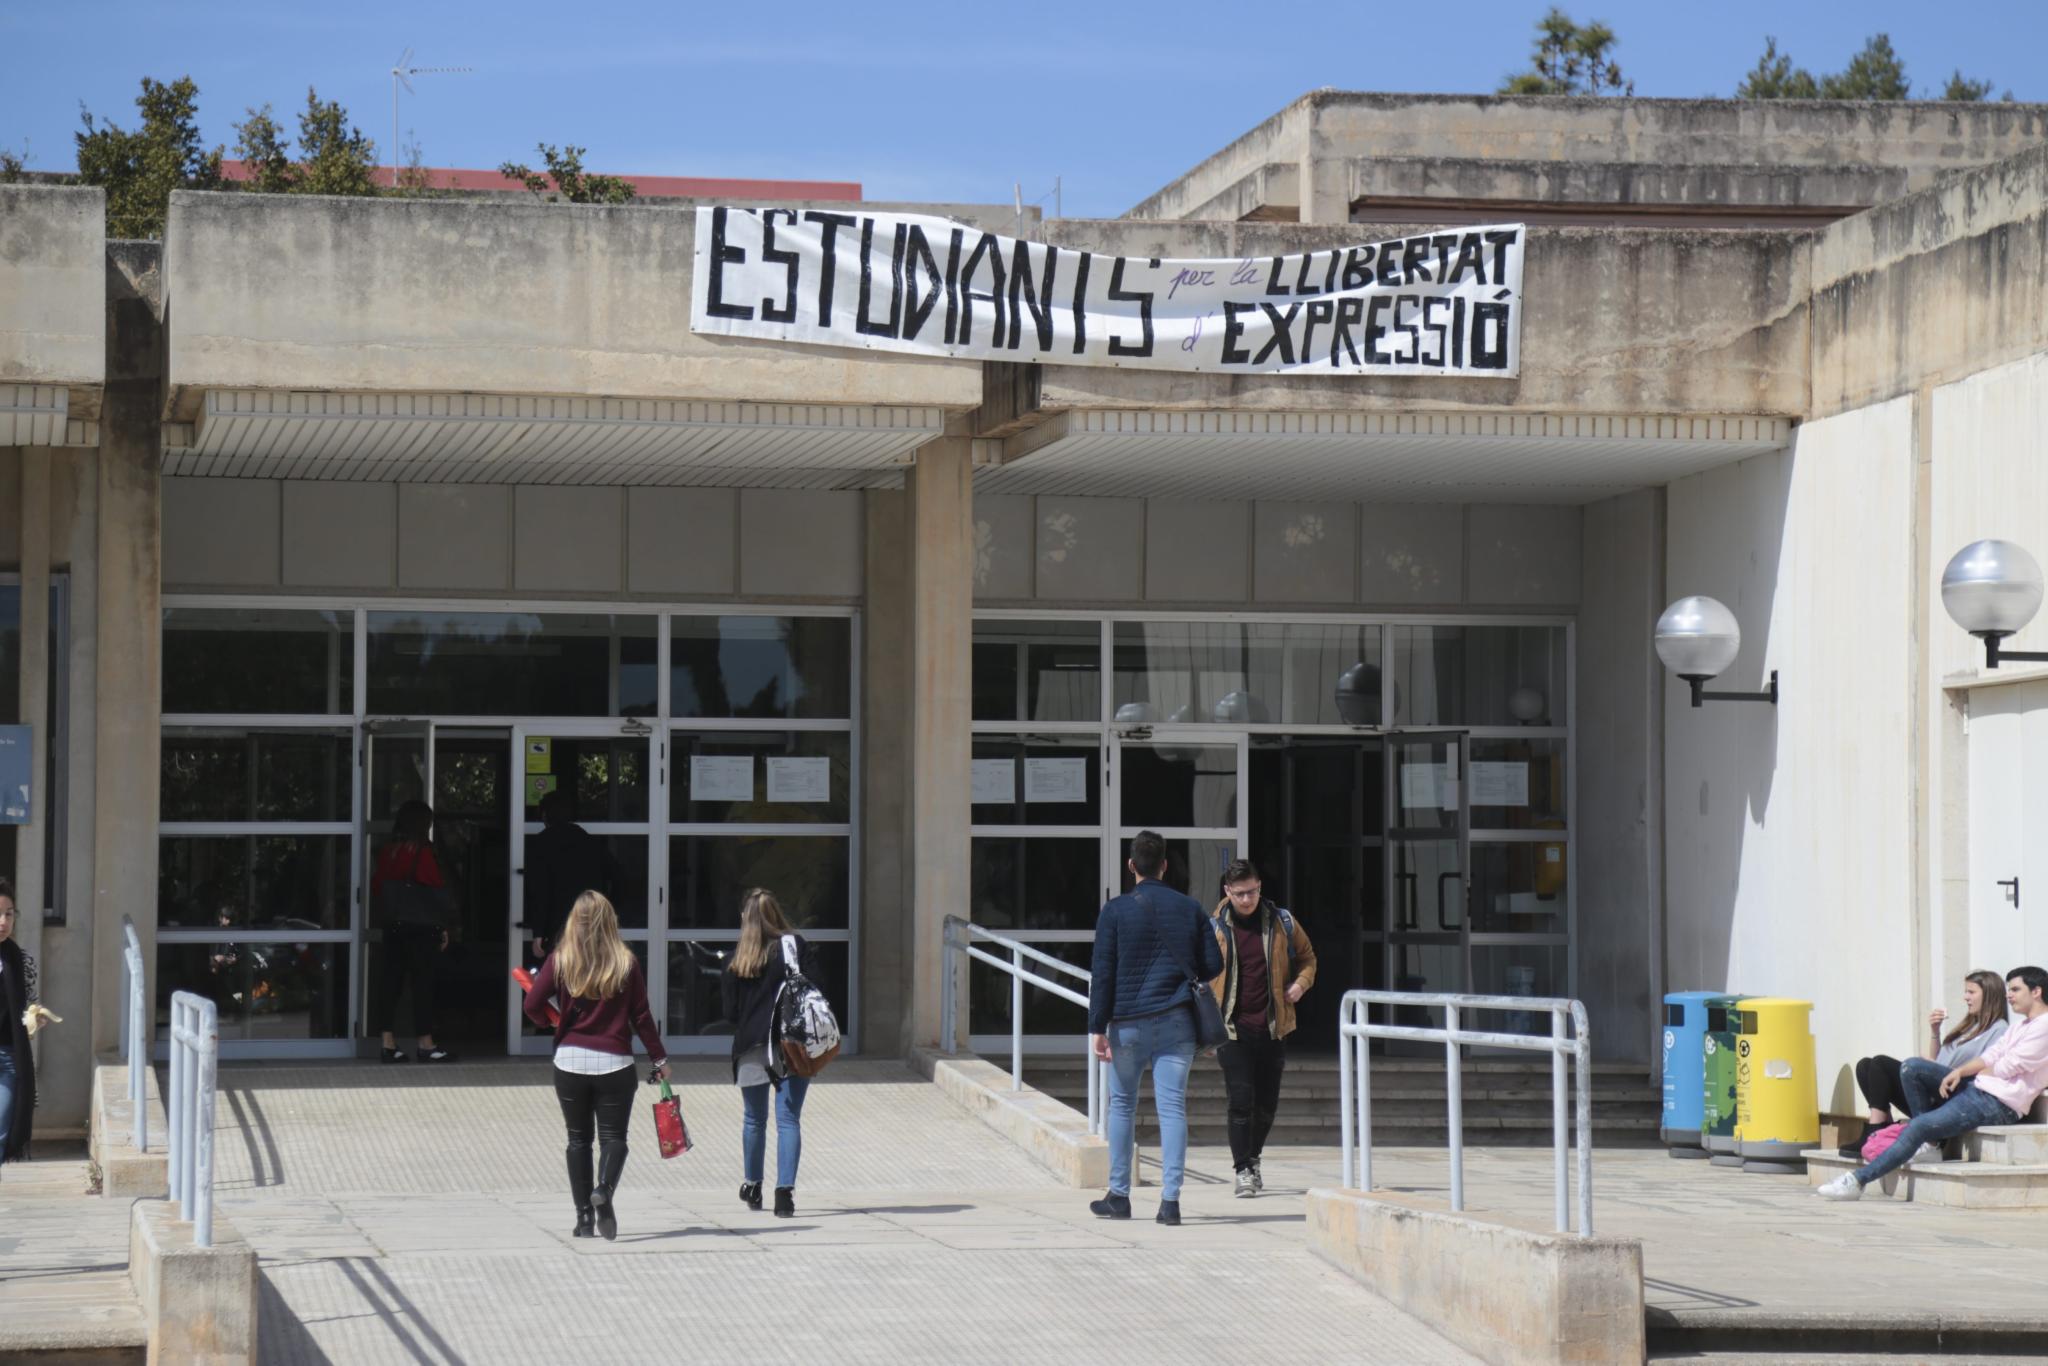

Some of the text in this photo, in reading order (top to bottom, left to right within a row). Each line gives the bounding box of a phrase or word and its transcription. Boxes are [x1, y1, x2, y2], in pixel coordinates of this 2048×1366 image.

[1168, 265, 1215, 299] per
[1229, 258, 1264, 286] la
[1266, 230, 1518, 296] LLIBERTAT
[1221, 289, 1511, 369] EXPRESSIÓ
